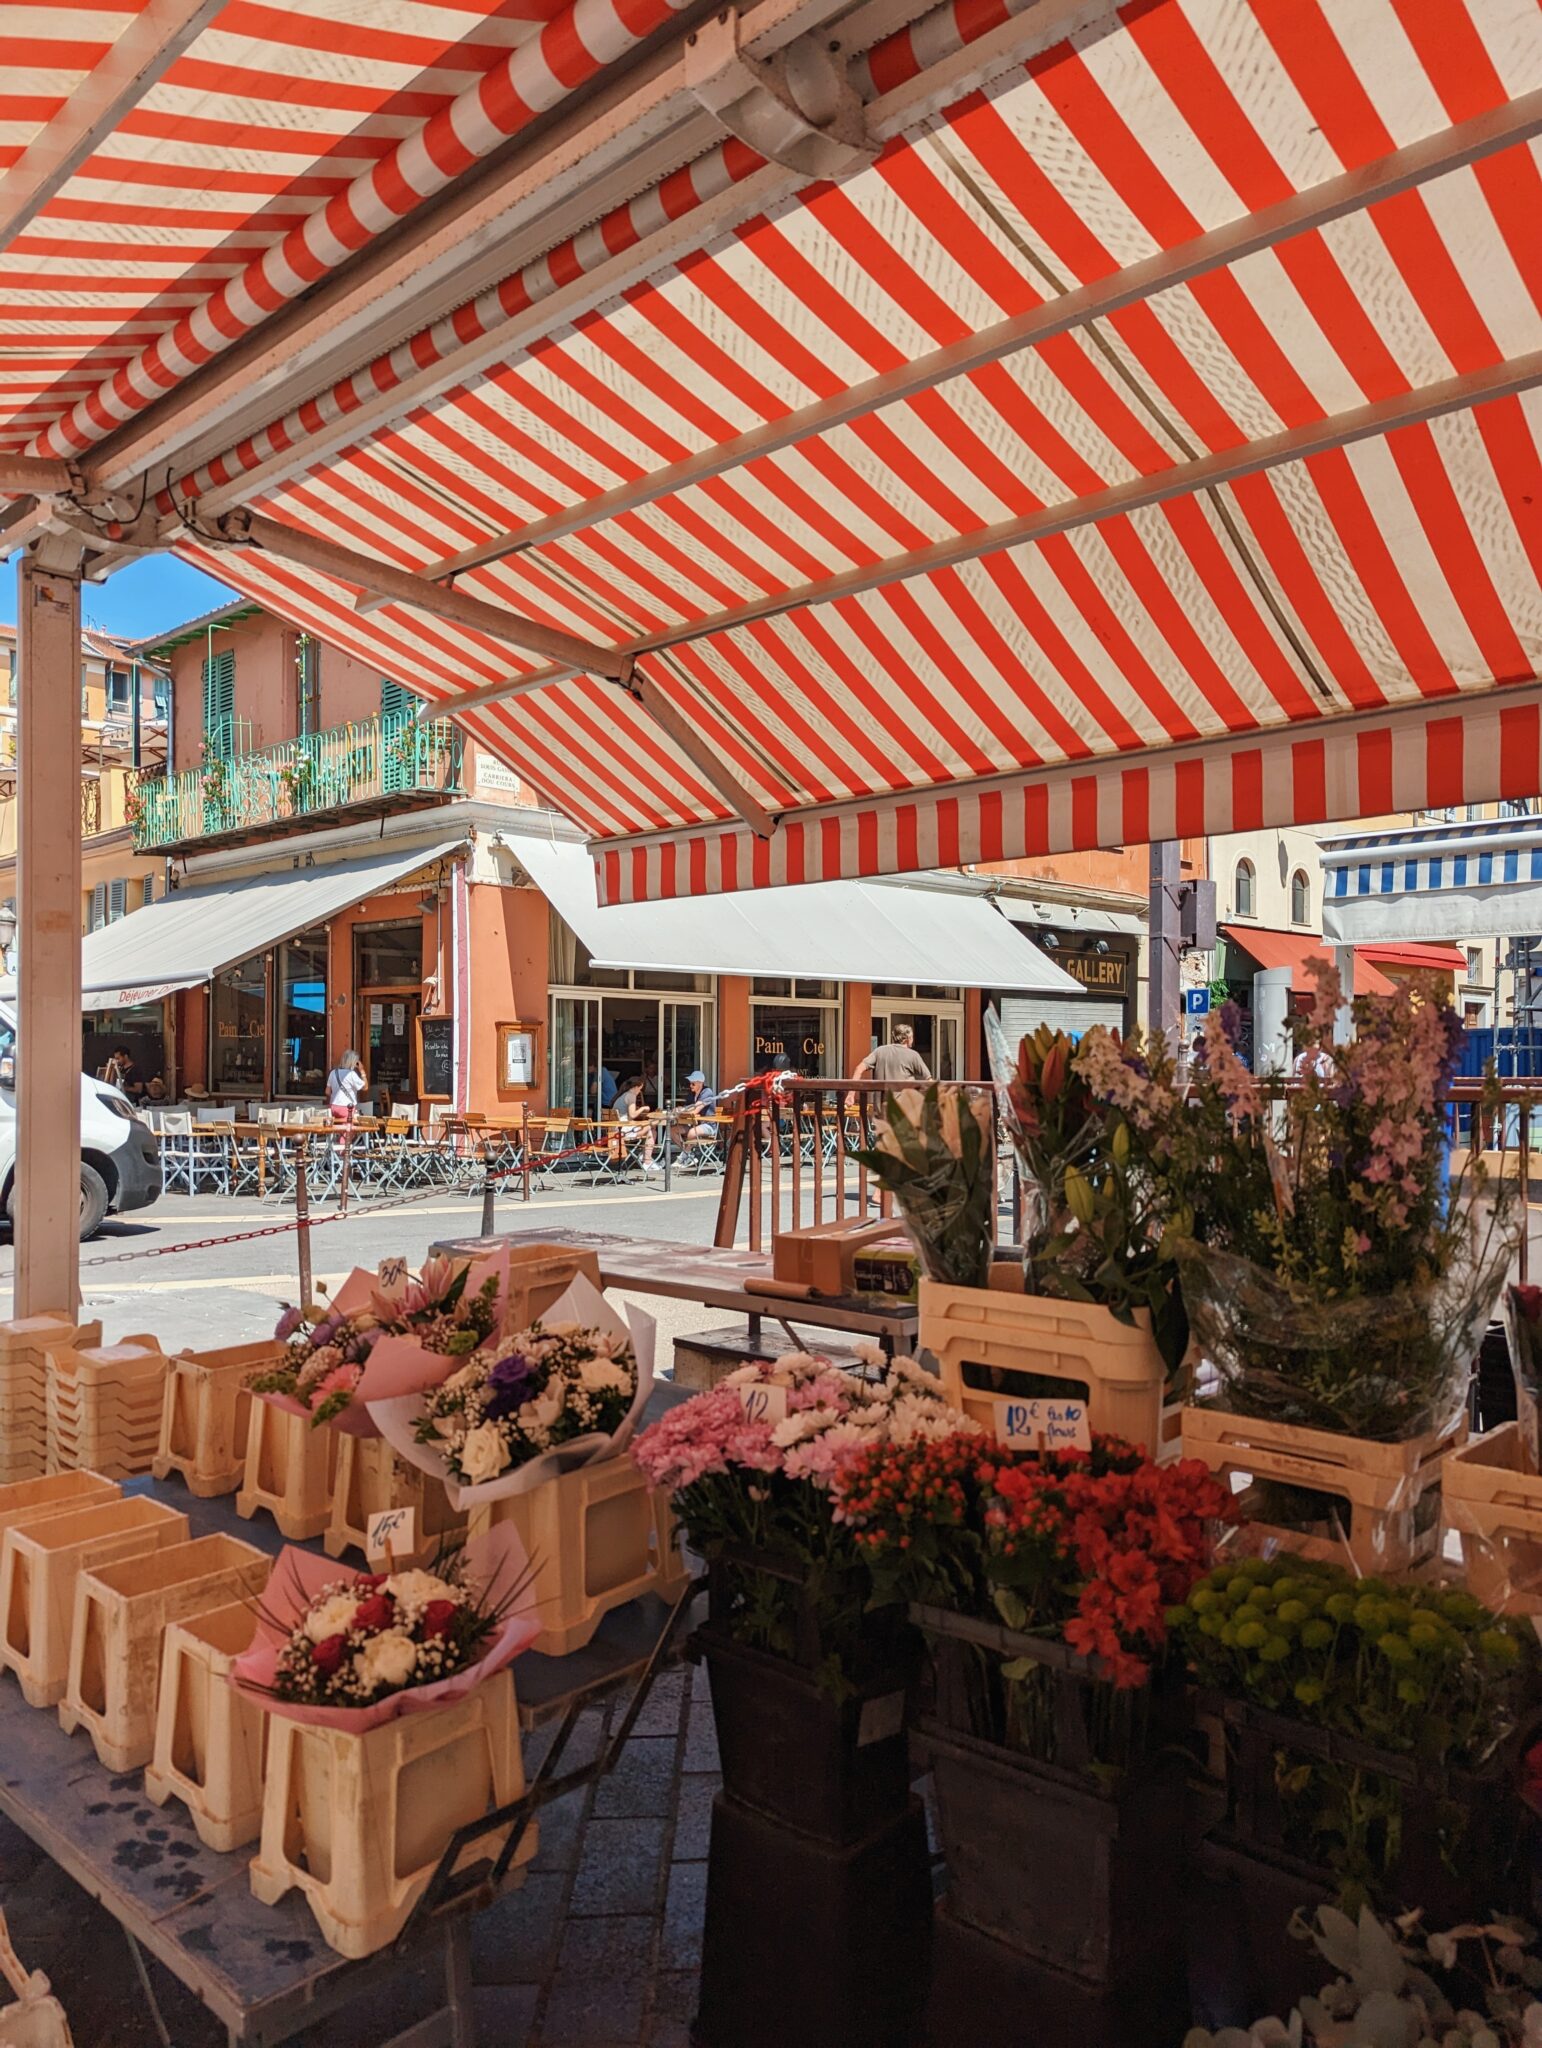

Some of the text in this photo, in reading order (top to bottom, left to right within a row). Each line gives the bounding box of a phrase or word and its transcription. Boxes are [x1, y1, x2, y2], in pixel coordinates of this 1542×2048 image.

[483, 772, 513, 783] CARRIERA
[1067, 959, 1122, 984] GALLERY
[119, 987, 159, 1005] Déjeuner
[1192, 993, 1204, 1010] P
[218, 1020, 237, 1038] Pain
[755, 1036, 825, 1055] Pain Cie
[745, 1389, 769, 1424] 12
